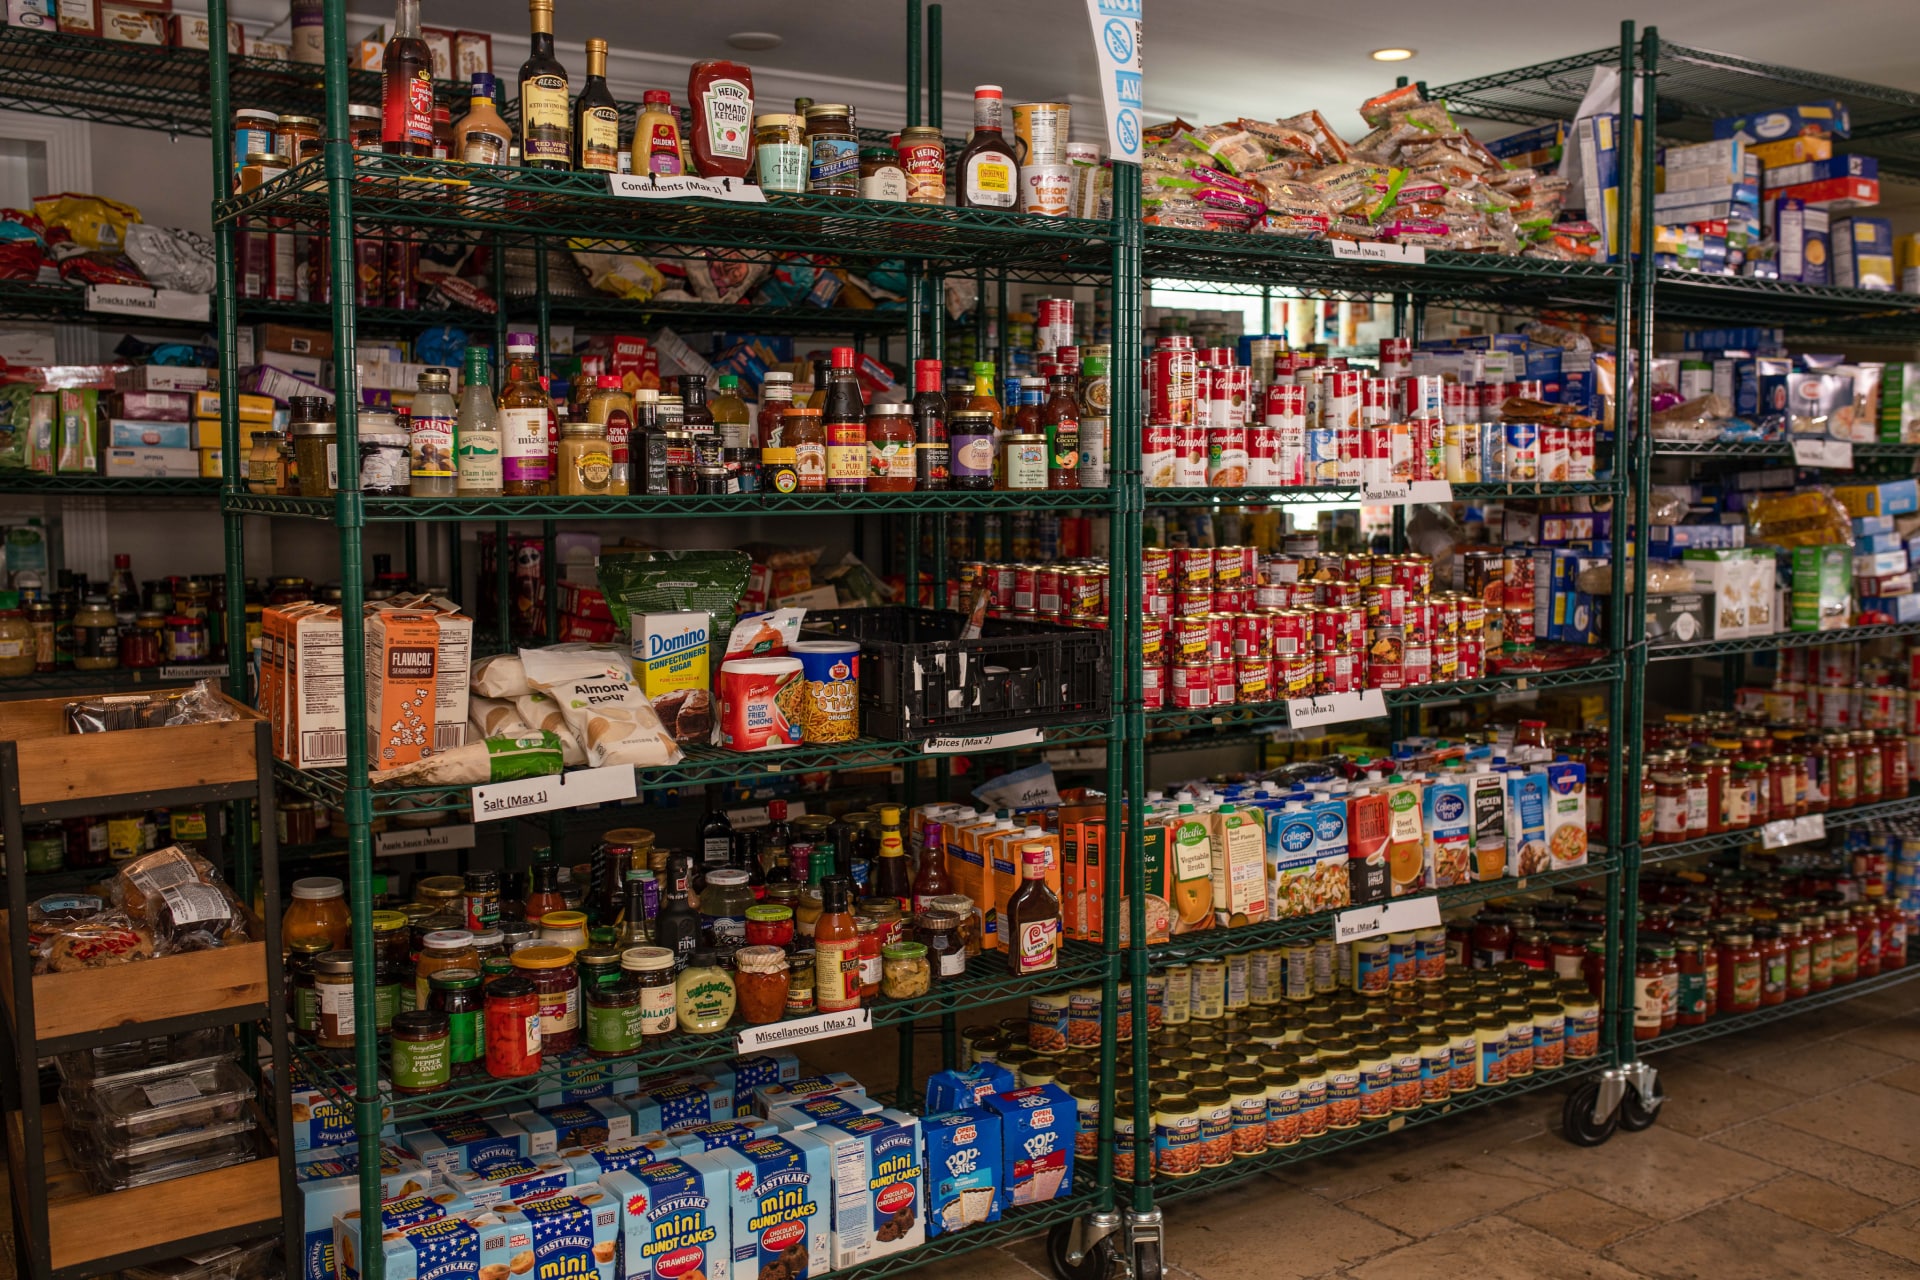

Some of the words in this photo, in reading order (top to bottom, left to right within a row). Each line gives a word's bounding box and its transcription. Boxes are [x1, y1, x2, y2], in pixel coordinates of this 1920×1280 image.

[717, 87, 744, 100] HEINZ
[713, 101, 747, 115] TOMATO
[413, 113, 431, 123] MALT
[714, 111, 746, 123] KETCHUP
[916, 148, 940, 158] HEINZ
[819, 162, 842, 175] SWEET
[621, 181, 684, 192] Condiments
[686, 179, 711, 193] (Max
[712, 185, 723, 195] 1)
[1038, 194, 1066, 205] Lunch
[1339, 247, 1361, 257] Ramen
[1363, 248, 1378, 259] (Max
[1379, 249, 1386, 258] 2)
[96, 295, 125, 307] Snacks
[126, 297, 144, 309] (Max
[461, 469, 480, 477] Clam
[481, 469, 498, 477] Juice
[1365, 490, 1383, 500] Soup
[1384, 488, 1399, 500] (Max
[1400, 488, 1406, 498] 2)
[1185, 556, 1212, 567] Beanee
[1215, 555, 1244, 567] Beanee
[1215, 561, 1244, 573] Weenee
[1180, 629, 1210, 640] Beanee
[649, 628, 705, 655] Domino
[392, 652, 432, 666] FLAVACOL
[649, 646, 707, 671] CONFECTIONERS
[391, 667, 419, 675] SEASONING
[419, 667, 431, 675] SALT
[669, 661, 692, 673] SUGAR
[1239, 667, 1269, 679] Beanee
[1239, 673, 1269, 685] Weenee
[1382, 670, 1399, 678] chili
[575, 682, 629, 695] Almond
[589, 693, 625, 705] Flour
[747, 704, 769, 712] CRISPY
[1295, 708, 1310, 717] Chili
[1311, 705, 1327, 717] (Max
[1327, 704, 1335, 714] 2)
[747, 712, 767, 720] FRIED
[747, 718, 773, 727] ONIONS
[961, 736, 983, 748] (Max
[984, 735, 993, 746] 2)
[483, 795, 504, 811] Salt
[507, 793, 533, 809] (Max
[535, 790, 548, 803] 1)
[1435, 801, 1464, 815] College
[1442, 811, 1456, 820] Inn
[1396, 819, 1413, 827] Beef
[1177, 826, 1205, 839] Pacific
[1282, 829, 1312, 843] College
[1322, 829, 1335, 840] Inn
[1396, 826, 1417, 836] Broth
[1289, 840, 1303, 849] Inn
[1180, 853, 1210, 865] Vegetable
[1186, 862, 1206, 872] Broth
[1341, 926, 1355, 937] Rice
[679, 939, 696, 950] FINI
[755, 1025, 820, 1042] Miscellaneous
[823, 1020, 845, 1034] (Max
[846, 1016, 856, 1029] 2)
[414, 1057, 442, 1067] PEPPER
[418, 1063, 443, 1073] ONION
[974, 1085, 993, 1095] OPEN
[1033, 1109, 1051, 1118] OPEN
[1037, 1115, 1053, 1124] FOLD
[956, 1125, 975, 1135] OPEN
[960, 1132, 976, 1141] FOLD
[875, 1136, 914, 1155] TASTYKAKE
[471, 1149, 517, 1166] TASTYKAKE
[878, 1153, 911, 1176] mini
[738, 1175, 752, 1187] NEW!
[870, 1174, 896, 1190] BUNDT
[896, 1166, 921, 1182] CAKES
[754, 1173, 810, 1196] TASTYKAKE
[882, 1188, 909, 1200] CHOCOLATE
[630, 1199, 645, 1212] NEW!
[761, 1187, 803, 1215] mini
[647, 1197, 709, 1222] TASTYKAKE
[749, 1211, 783, 1231] BUNDT
[784, 1202, 817, 1220] CAKES
[655, 1212, 701, 1240] mini
[769, 1225, 798, 1236] CHOCOLATE
[511, 1234, 525, 1242] NEW
[643, 1238, 679, 1257] BUNDT
[680, 1227, 715, 1247] CAKES
[763, 1232, 793, 1245] CHOCOLATE
[538, 1235, 592, 1257] TASTYKAKE
[540, 1253, 588, 1280] mini
[658, 1252, 702, 1271] STRAWBERRY
[419, 1261, 477, 1280] TASTYKAKE
